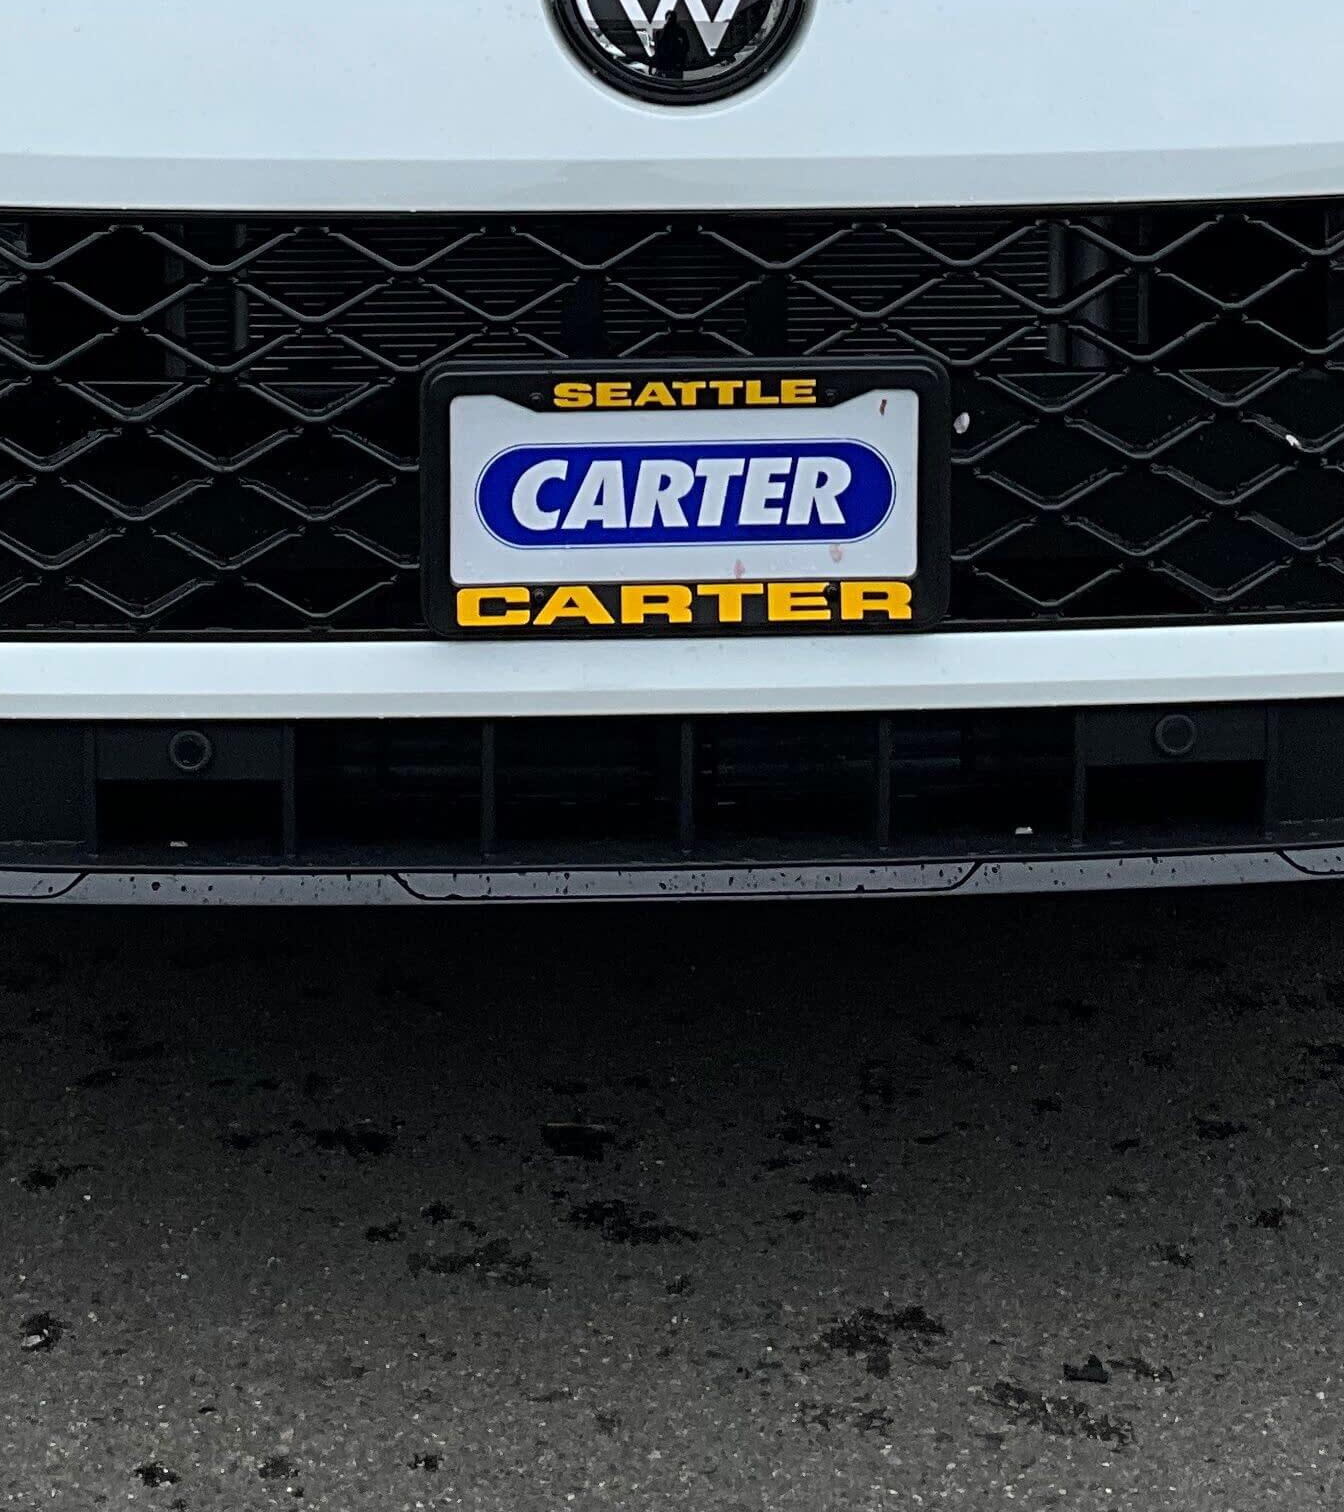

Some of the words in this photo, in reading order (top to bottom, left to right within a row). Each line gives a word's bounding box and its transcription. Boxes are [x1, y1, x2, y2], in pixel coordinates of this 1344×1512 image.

[552, 379, 818, 409] SEATTLE
[510, 455, 853, 531] CARTER
[455, 581, 914, 627] CARTER
